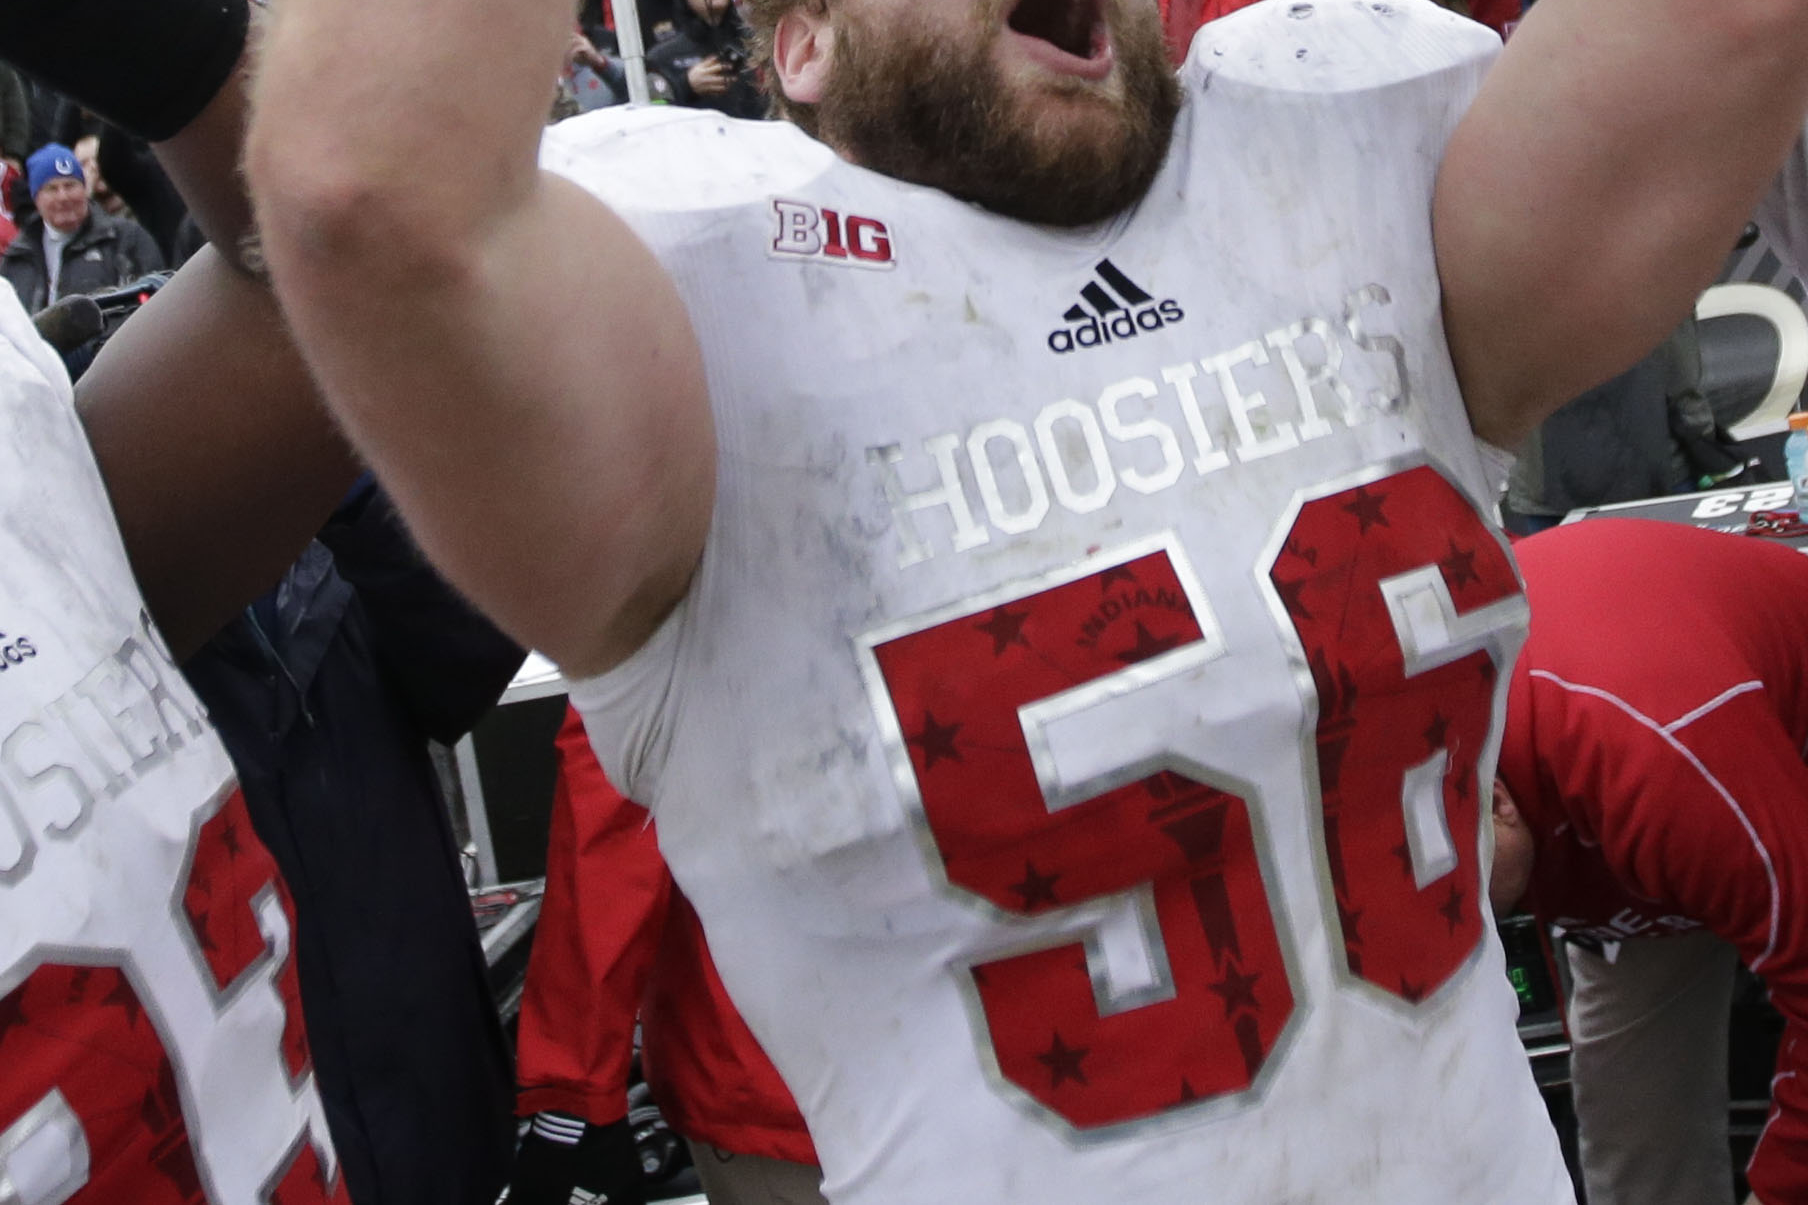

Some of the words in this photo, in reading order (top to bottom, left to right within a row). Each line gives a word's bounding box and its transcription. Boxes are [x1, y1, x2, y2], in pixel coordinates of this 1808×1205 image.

[864, 281, 1410, 570] HOOSIERS
[1047, 297, 1186, 354] adidas
[850, 450, 1532, 1152] 56
